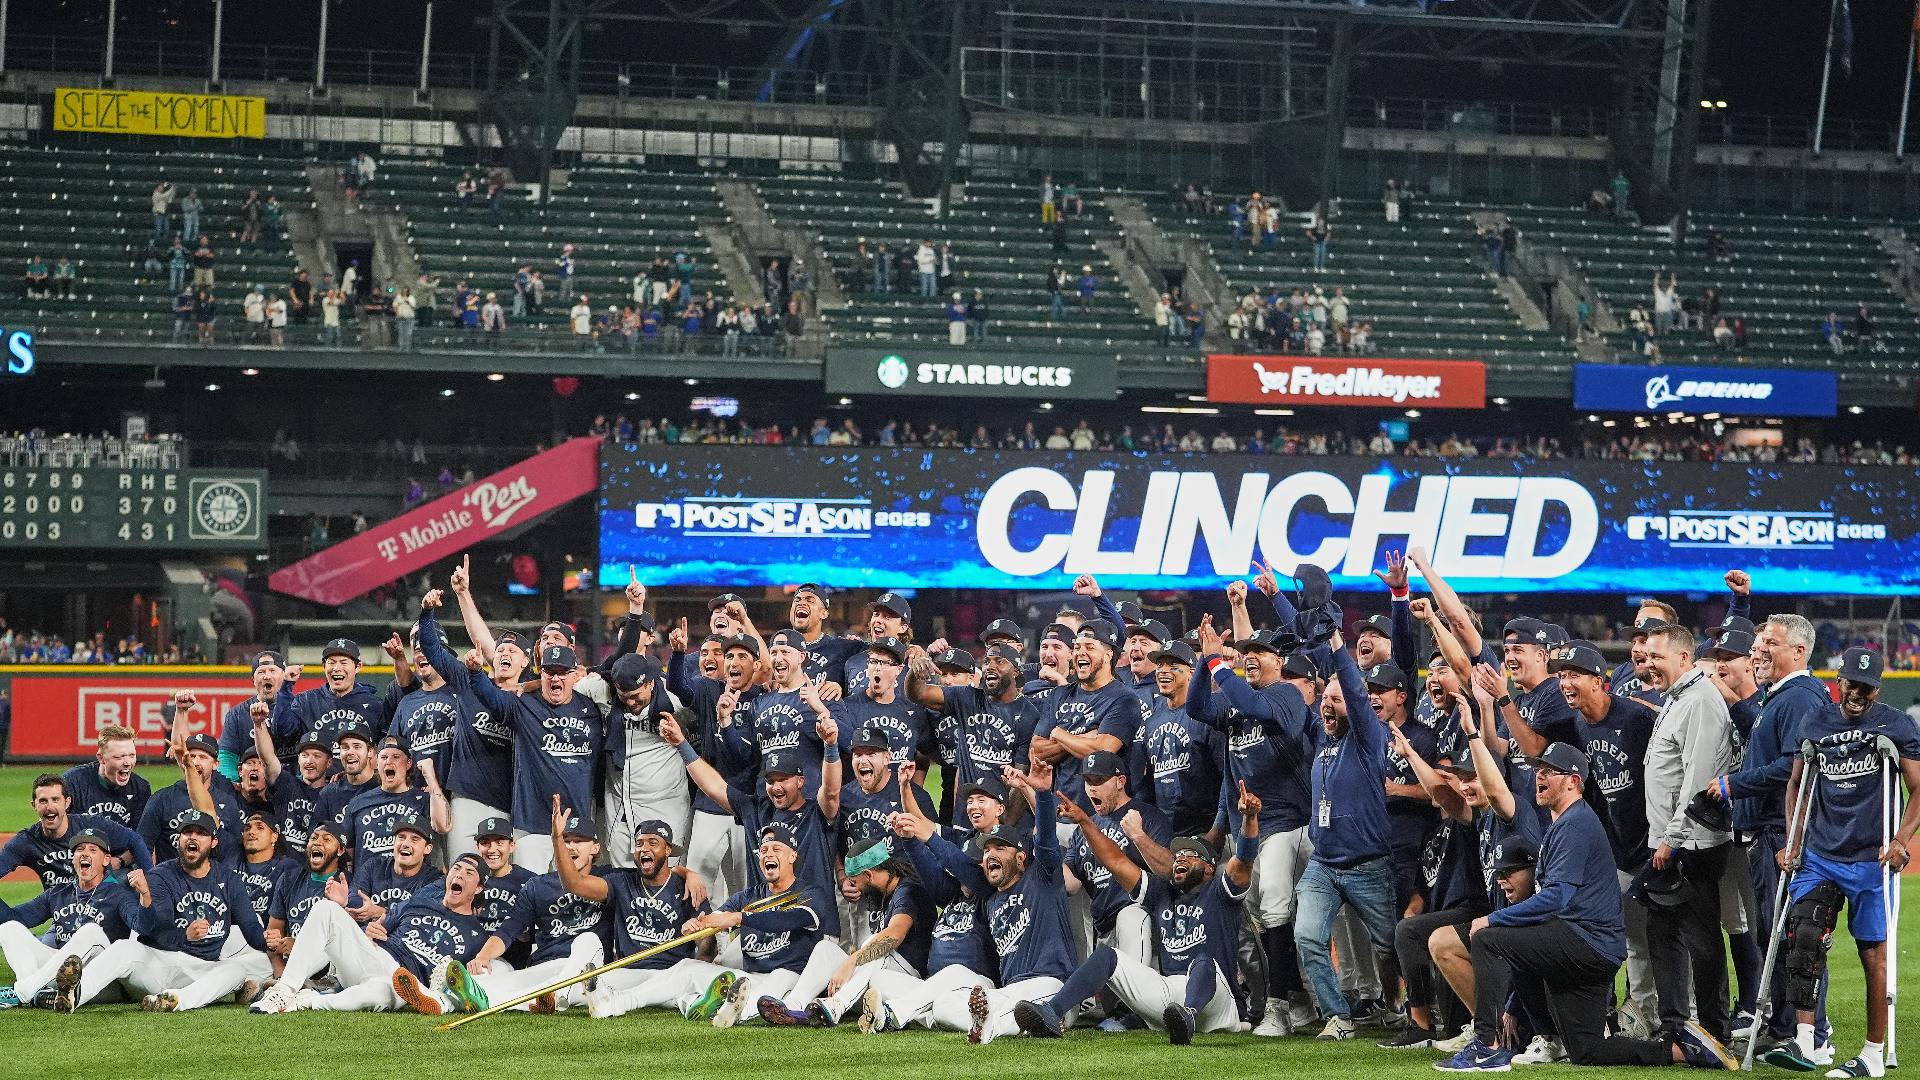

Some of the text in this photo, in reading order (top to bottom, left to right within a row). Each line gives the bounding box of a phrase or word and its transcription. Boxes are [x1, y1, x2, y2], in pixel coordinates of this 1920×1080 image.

[62, 91, 254, 134] SEIZE THE MOMENT
[917, 363, 1073, 388] STARBUCKS
[1676, 380, 1773, 399] BOEING
[3, 473, 177, 490] 6 7 8 9 R H E
[3, 497, 176, 514] 2 0 0 0 3 7 0
[874, 511, 931, 527] 2025
[976, 466, 1599, 580] CLINCHED
[3, 522, 174, 540] 0 0 3 4 3 1
[399, 508, 473, 554] Mobile
[1837, 524, 1886, 539] 2025
[755, 705, 803, 728] OCTOBER
[863, 716, 913, 741] CTOBER
[1817, 753, 1880, 781] Baseball
[84, 802, 131, 824] CTOBER
[362, 803, 418, 825] OCTOBE
[283, 819, 308, 842] Base
[362, 832, 395, 853] Base
[42, 871, 76, 890] Base
[176, 891, 228, 916] OCTOBER
[289, 896, 327, 917] OCTO
[484, 888, 516, 906] TOBE
[410, 915, 466, 956] OCTOBER
[402, 929, 450, 965] Baseba
